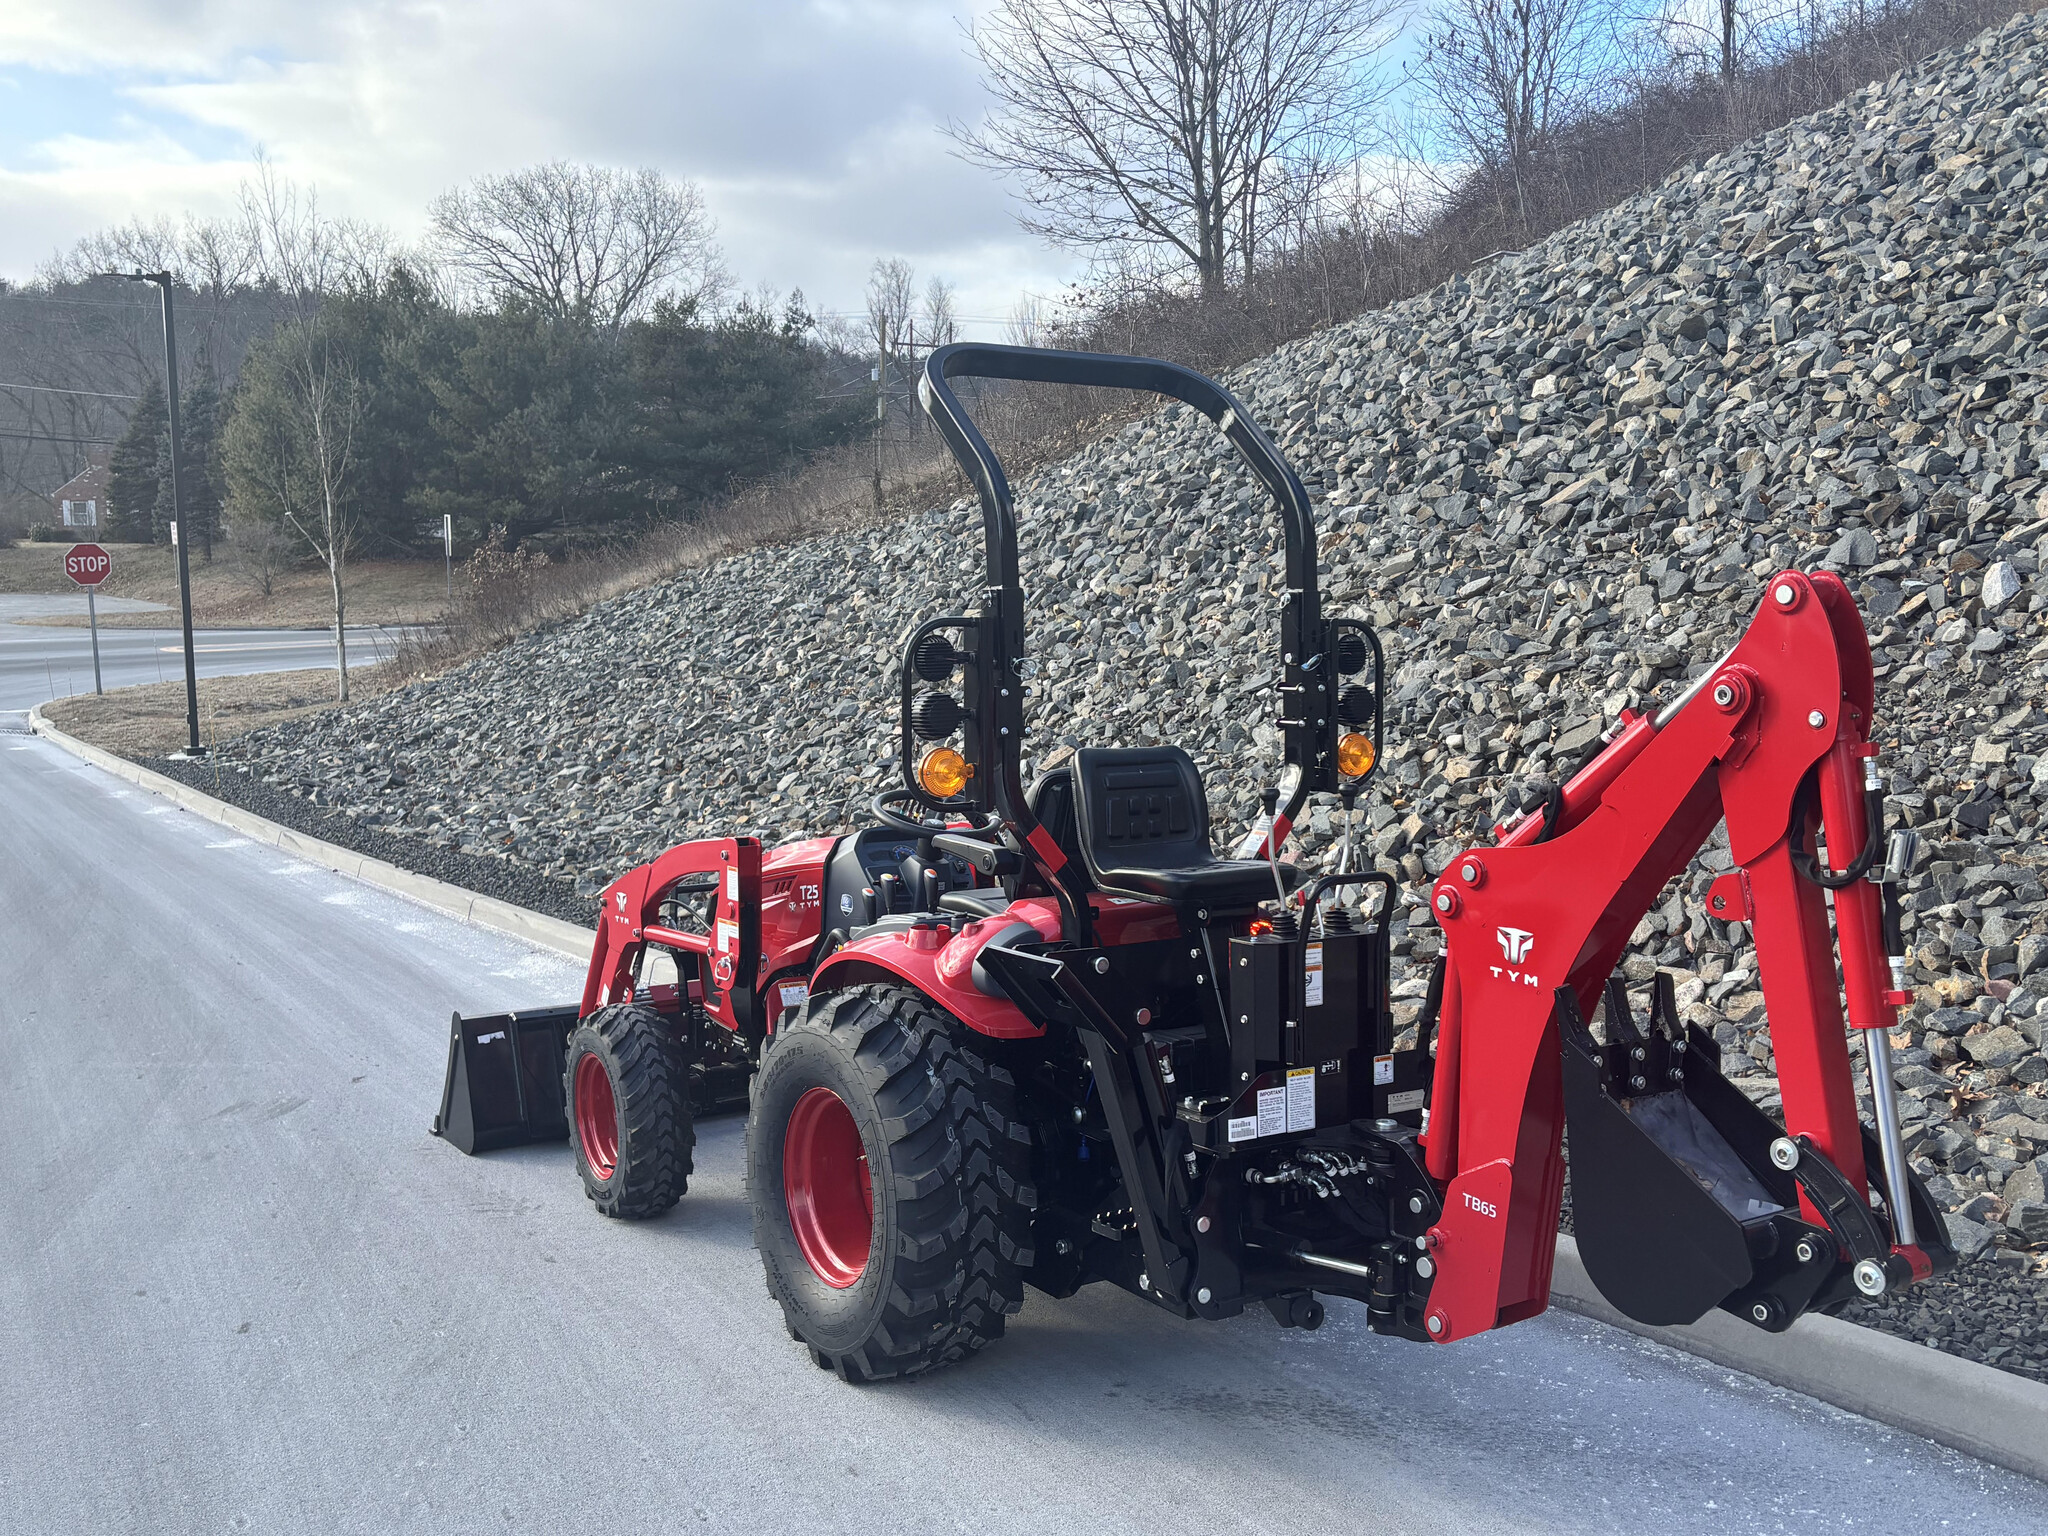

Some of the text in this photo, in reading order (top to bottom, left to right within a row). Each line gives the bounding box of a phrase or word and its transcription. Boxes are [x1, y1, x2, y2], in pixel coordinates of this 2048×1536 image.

[68, 556, 108, 573] STOP
[800, 885, 819, 900] T25
[799, 900, 820, 909] TYM
[615, 915, 630, 925] TYM
[1489, 965, 1538, 987] TYM
[1259, 1088, 1284, 1098] IMPORTANT
[1462, 1192, 1497, 1219] TB65
